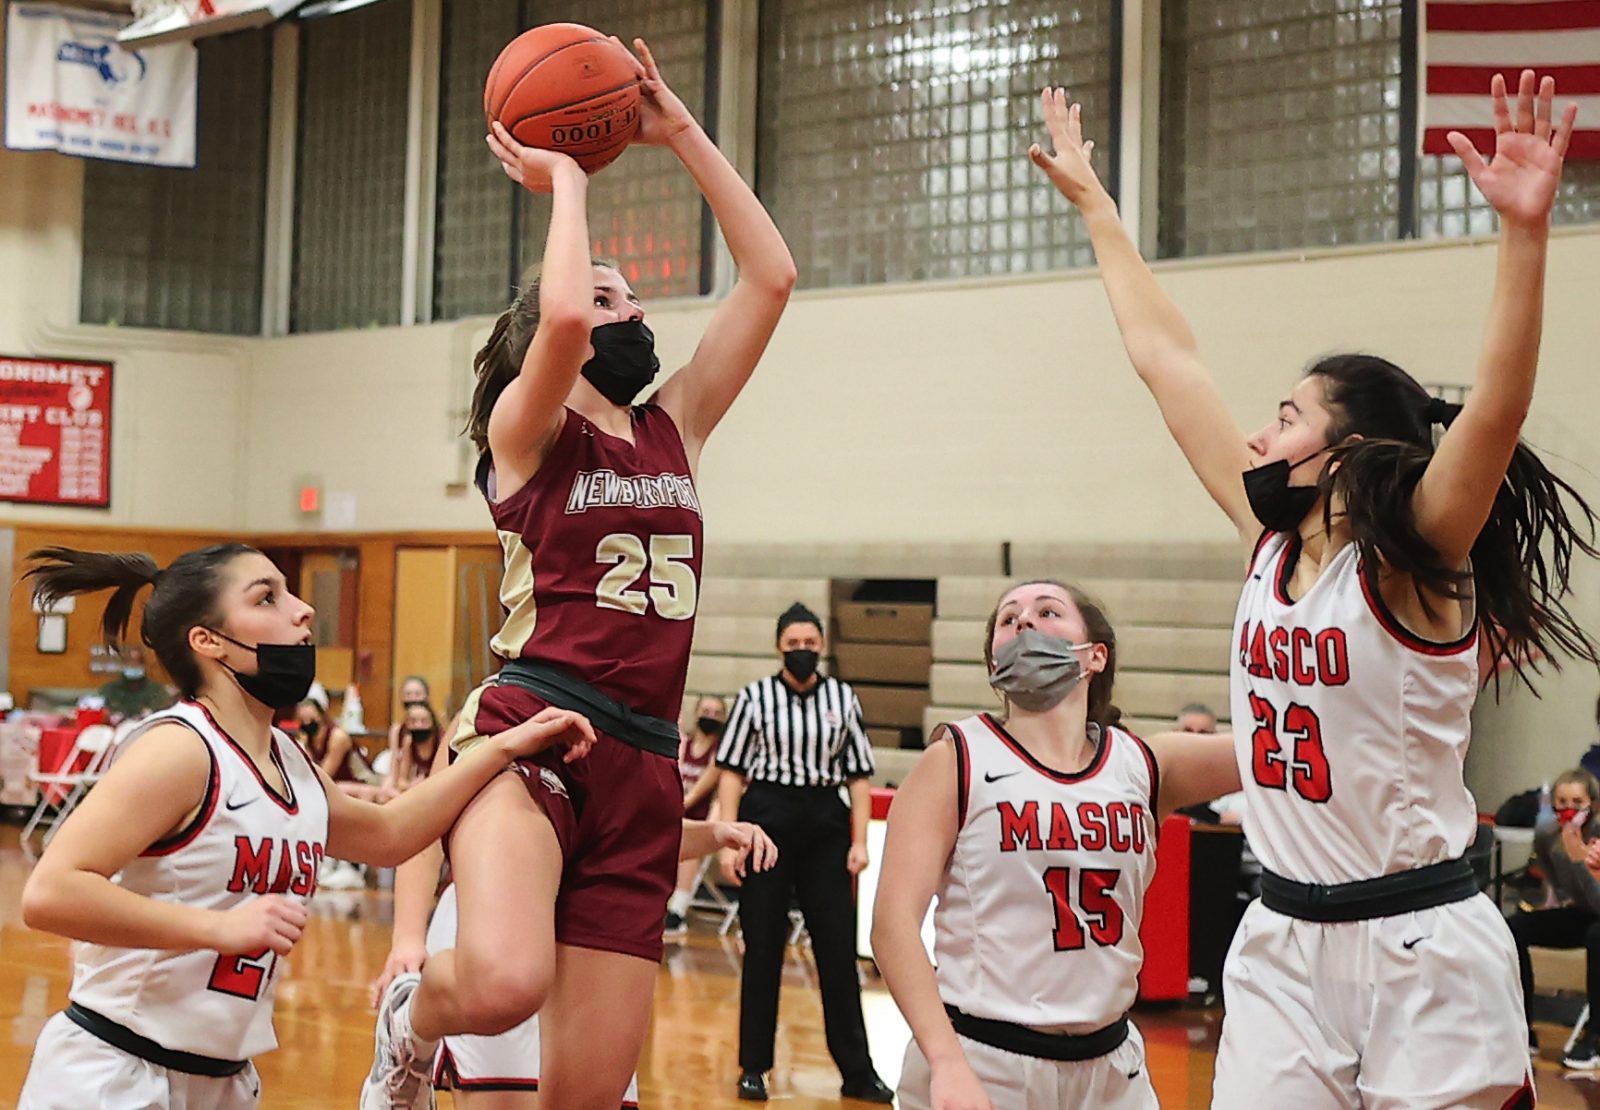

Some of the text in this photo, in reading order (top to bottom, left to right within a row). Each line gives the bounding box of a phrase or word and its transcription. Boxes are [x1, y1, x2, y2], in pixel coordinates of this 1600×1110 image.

[596, 534, 697, 620] 25
[1249, 690, 1333, 803] 23
[997, 801, 1146, 854] MASCO
[1042, 866, 1125, 951] 15
[207, 948, 278, 1001] 2
